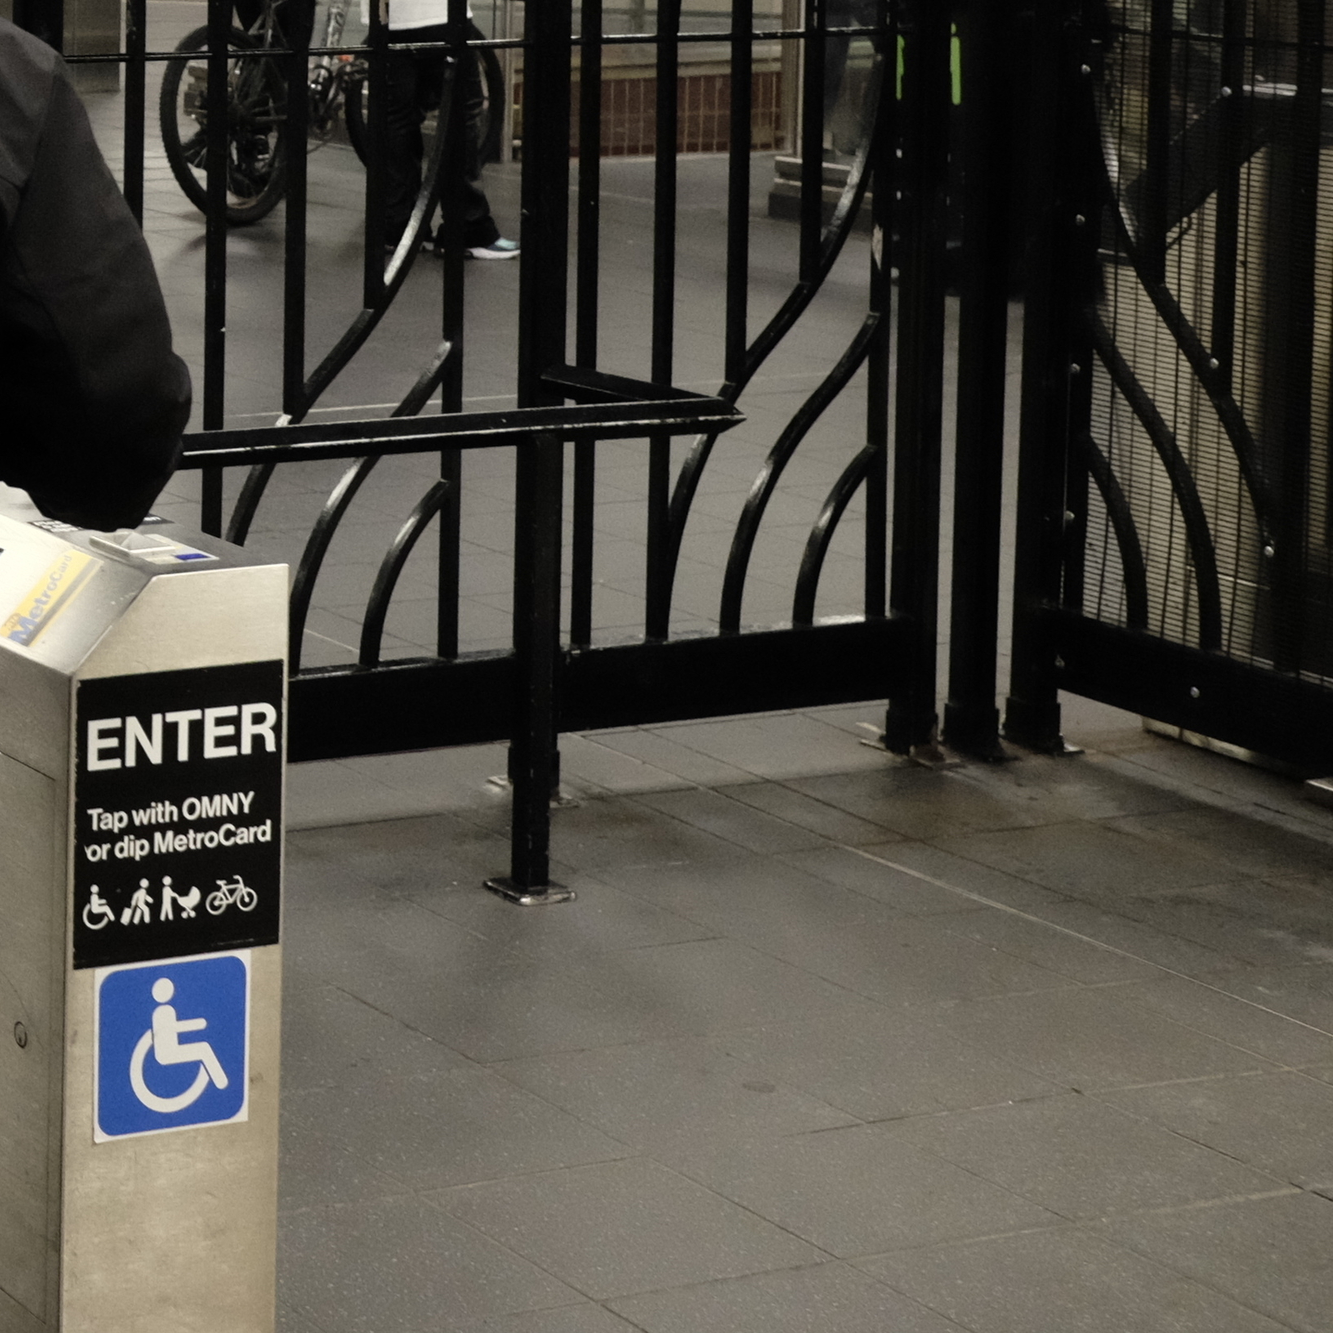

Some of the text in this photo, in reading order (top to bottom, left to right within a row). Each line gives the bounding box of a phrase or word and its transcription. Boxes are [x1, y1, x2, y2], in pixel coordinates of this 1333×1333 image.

[8, 555, 73, 643] MetroCard
[87, 702, 277, 772] ENTER
[88, 790, 254, 832] Tap with OMNY
[86, 820, 272, 862] or dip MetroCard
